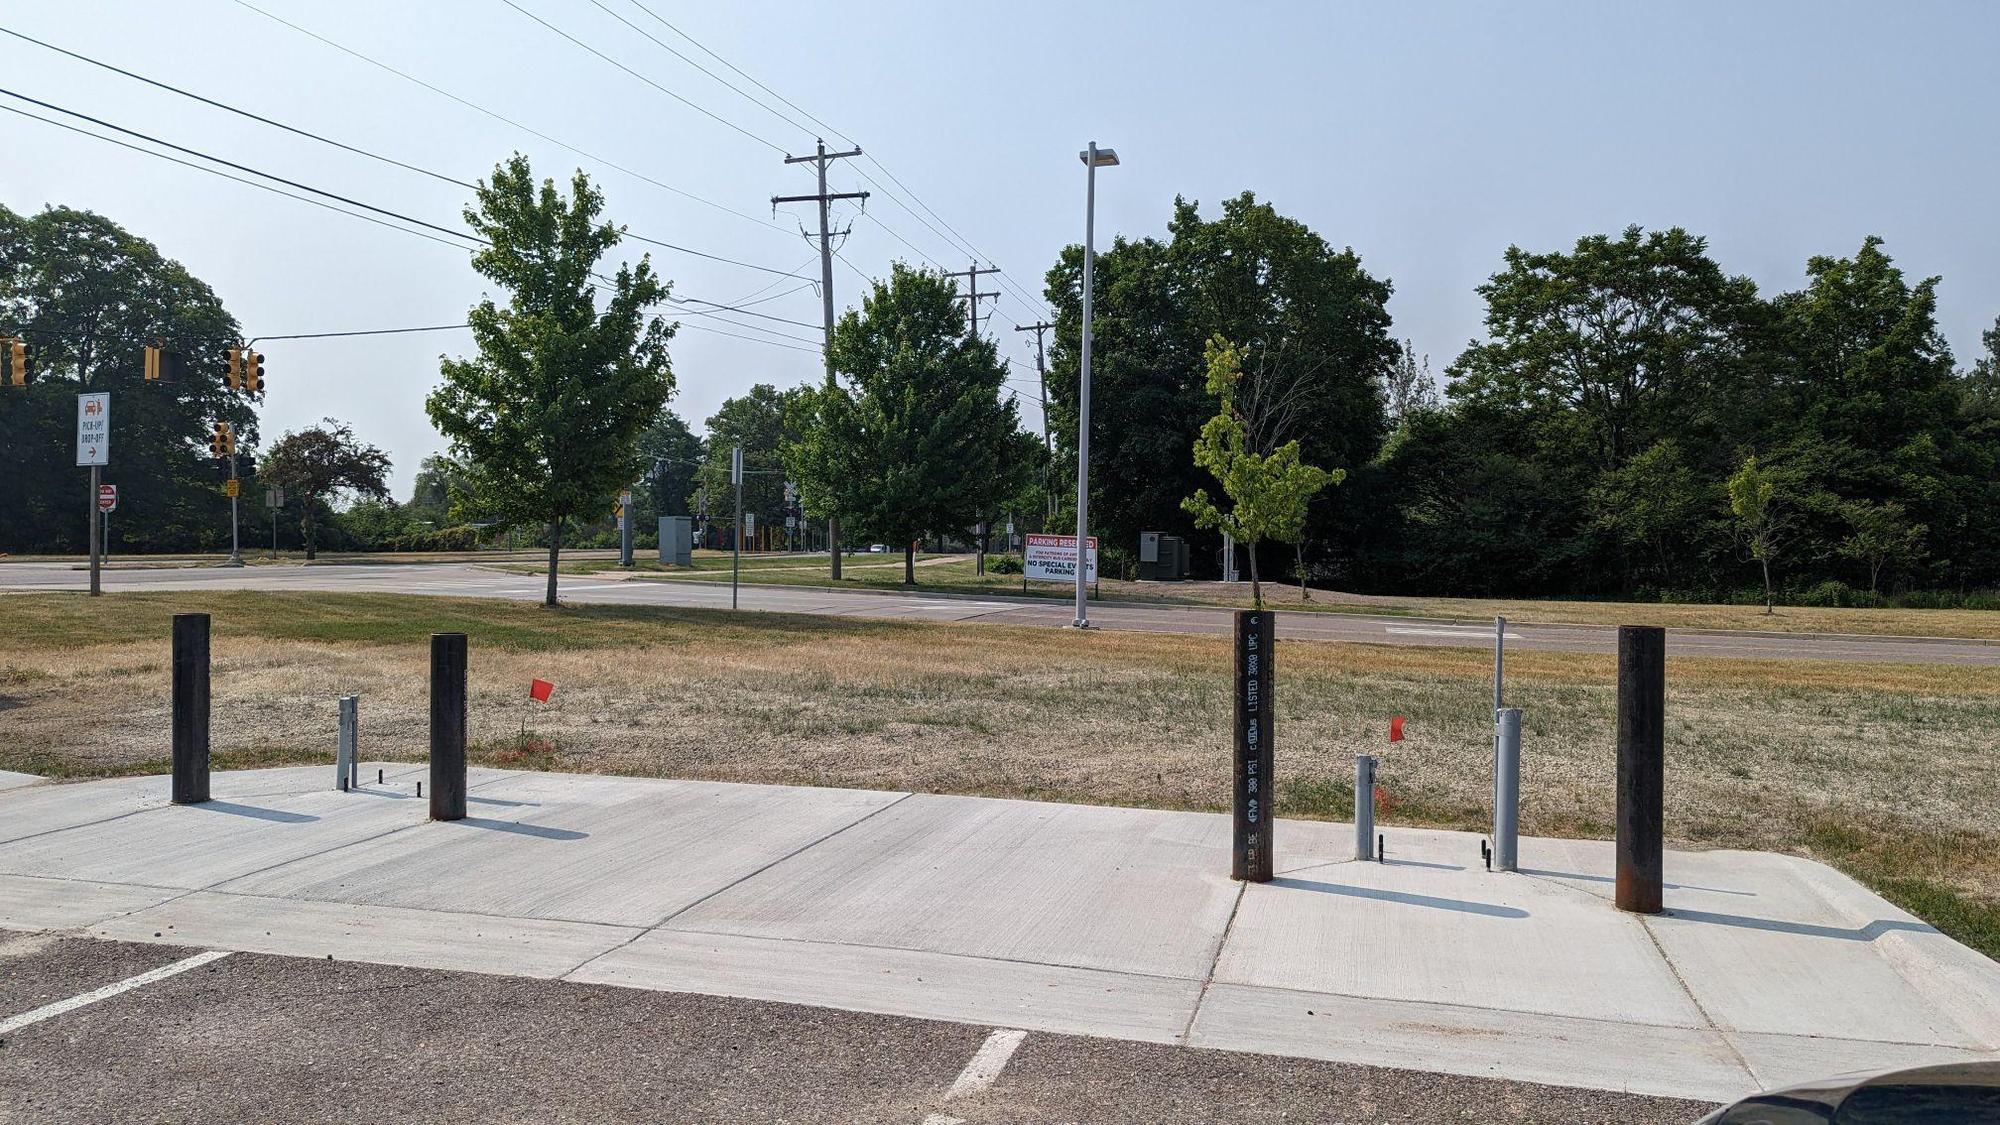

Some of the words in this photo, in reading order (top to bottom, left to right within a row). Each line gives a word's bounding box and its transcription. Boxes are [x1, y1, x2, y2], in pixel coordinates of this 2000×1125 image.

[1029, 537, 1059, 547] PARKING
[1038, 560, 1065, 569] SPECIAL
[1248, 633, 1258, 650] UPC
[1247, 680, 1258, 712] LISTED
[1247, 760, 1258, 775] PSI
[1248, 778, 1258, 794] 300
